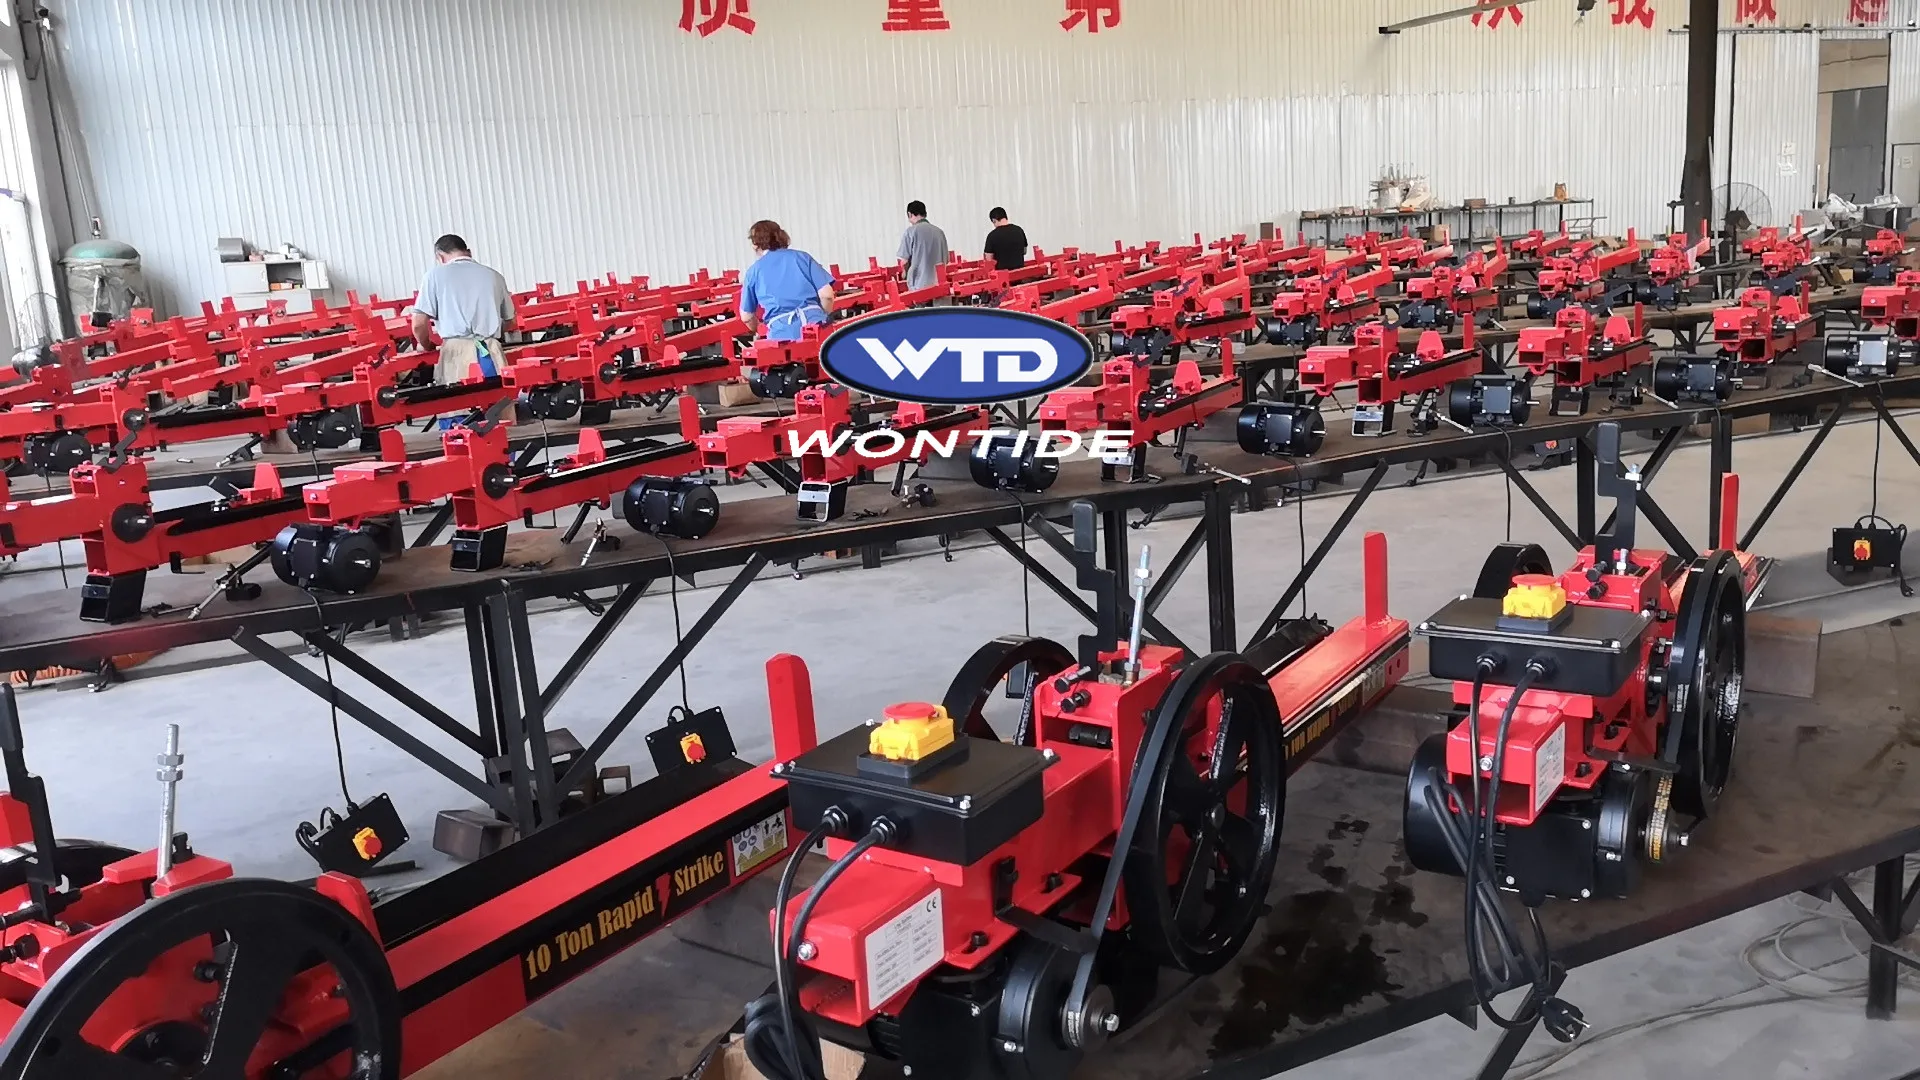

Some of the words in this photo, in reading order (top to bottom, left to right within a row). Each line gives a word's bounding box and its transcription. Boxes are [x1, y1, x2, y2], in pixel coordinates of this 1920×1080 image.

[526, 943, 551, 980] 10
[555, 922, 594, 962] Ton
[597, 885, 654, 939] Rapid
[673, 851, 724, 896] Strike
